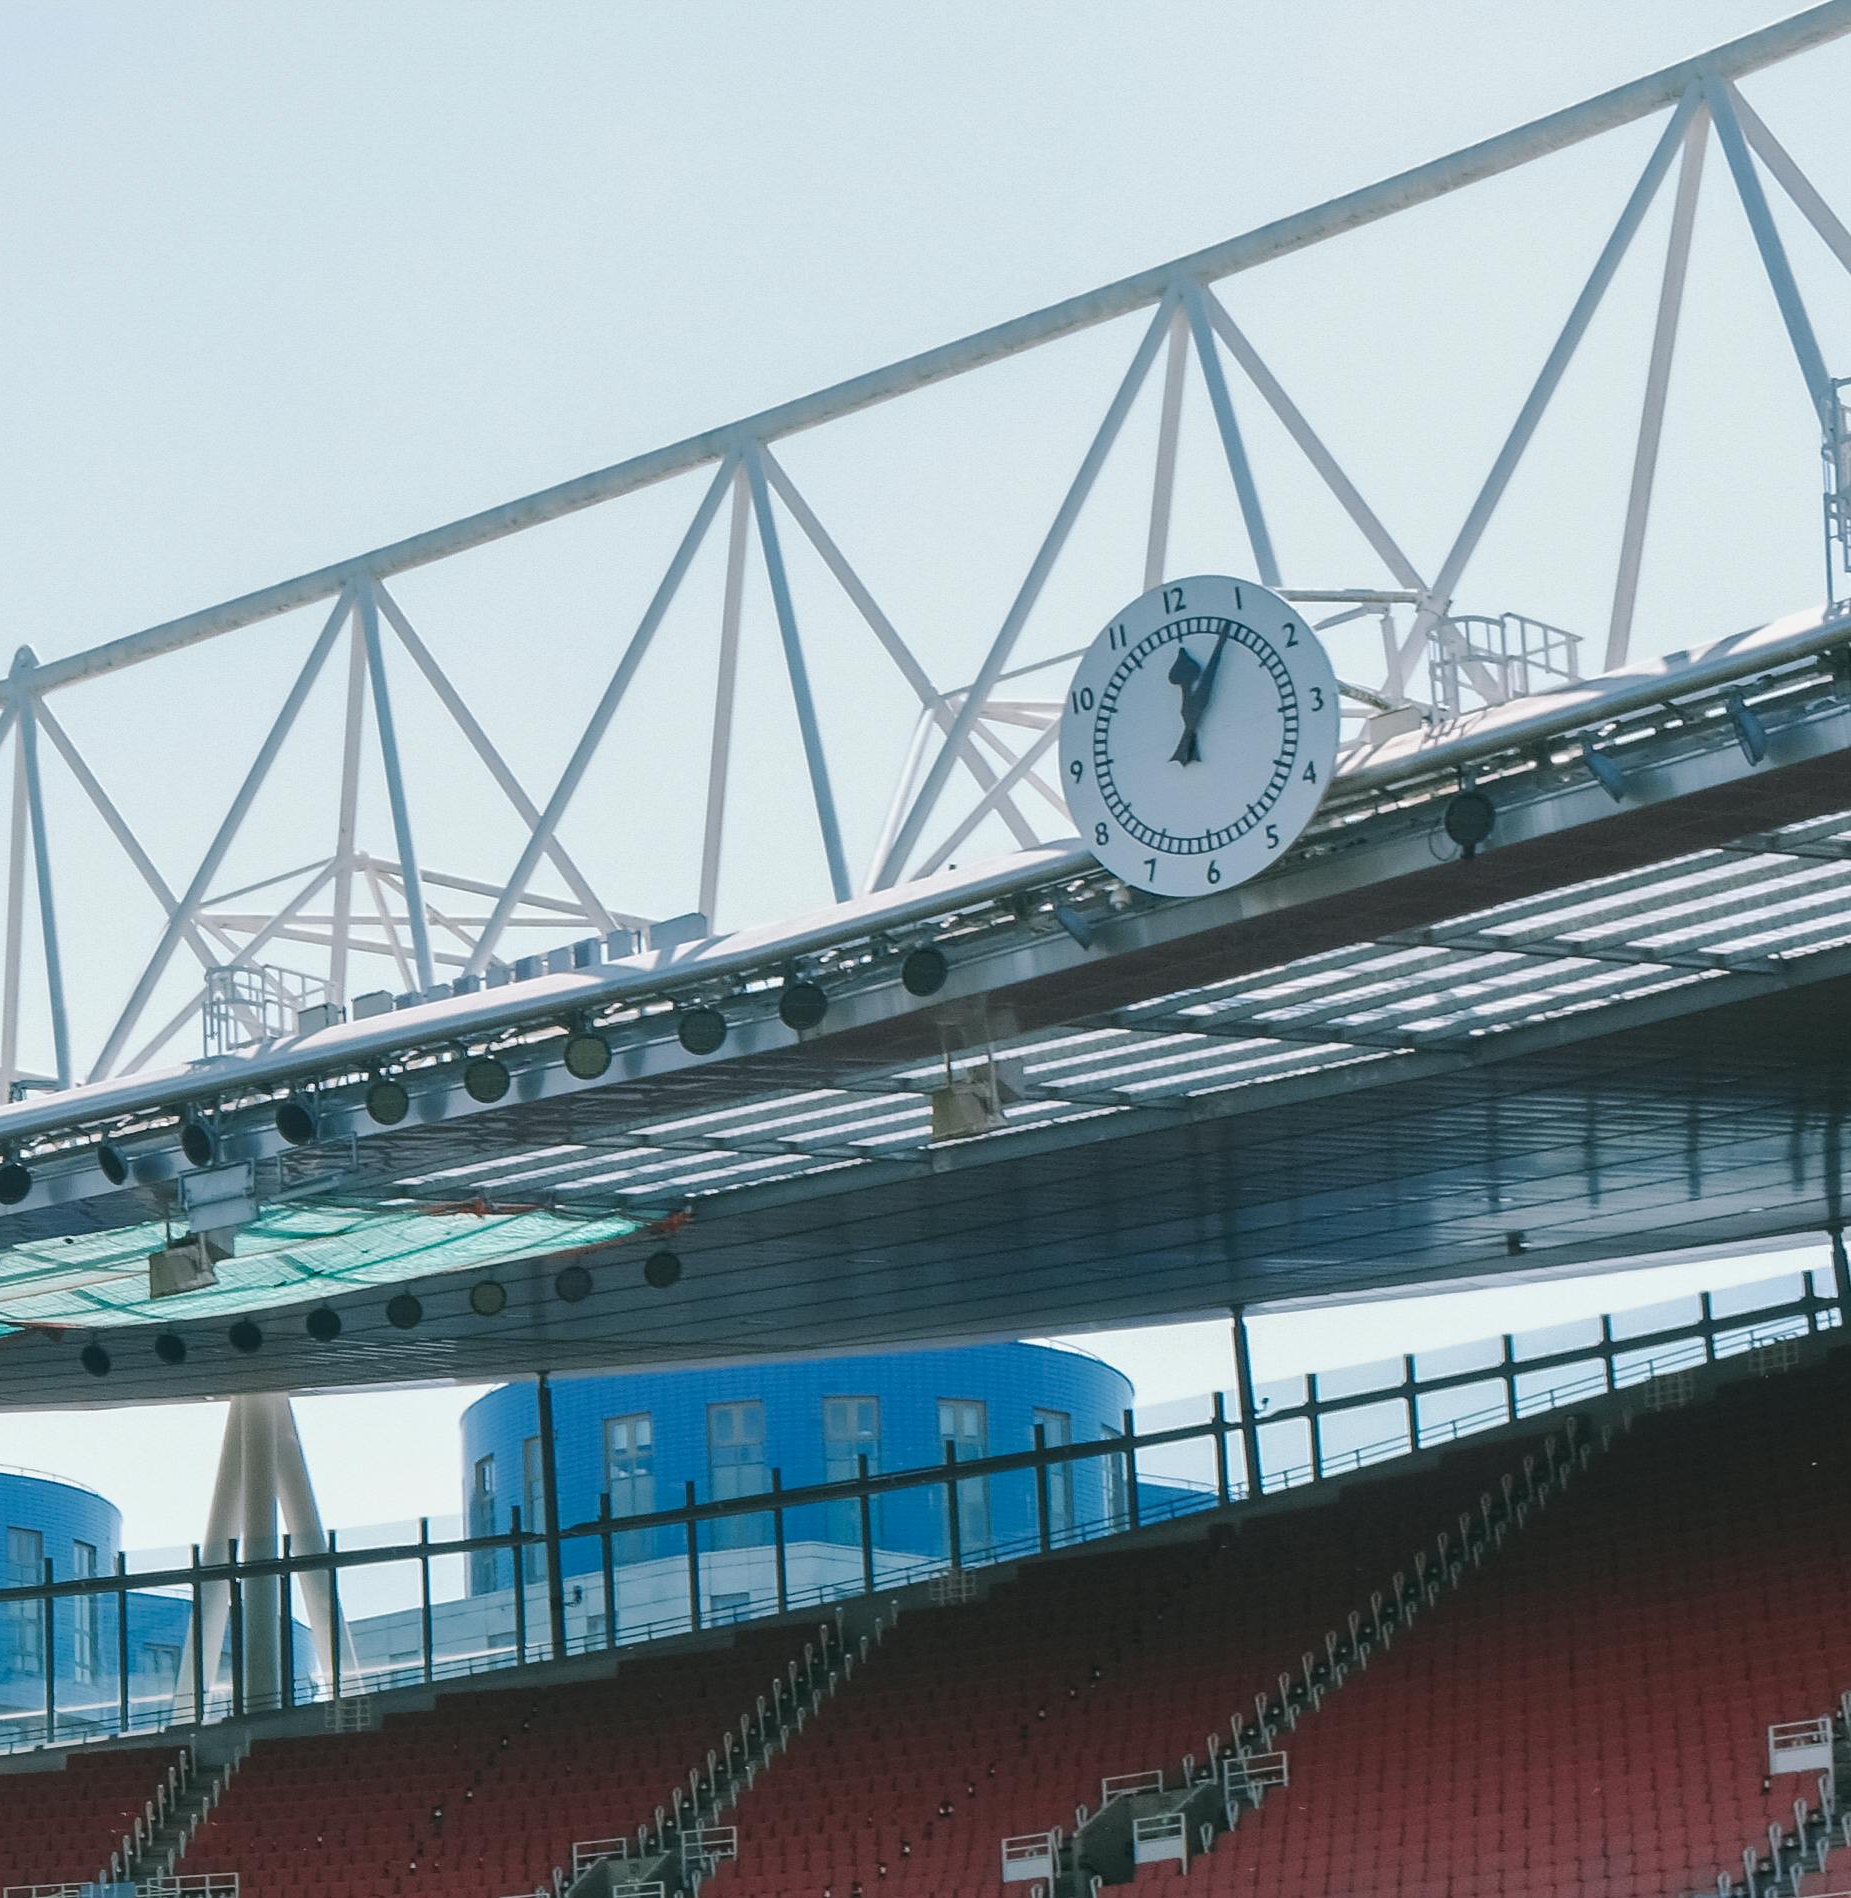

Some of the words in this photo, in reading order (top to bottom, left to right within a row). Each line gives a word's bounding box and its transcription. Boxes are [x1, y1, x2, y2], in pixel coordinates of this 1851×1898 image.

[1162, 586, 1187, 615] 12
[1234, 586, 1243, 610] 1
[1109, 624, 1127, 651] 11
[1282, 622, 1299, 648] 2
[1072, 687, 1094, 714] 10
[1309, 687, 1325, 712] 3
[1070, 760, 1084, 784] 9
[1302, 760, 1317, 785] 4
[1095, 822, 1110, 846] 8
[1266, 824, 1280, 850] 5
[1144, 858, 1158, 882] 7
[1207, 859, 1221, 885] 6
